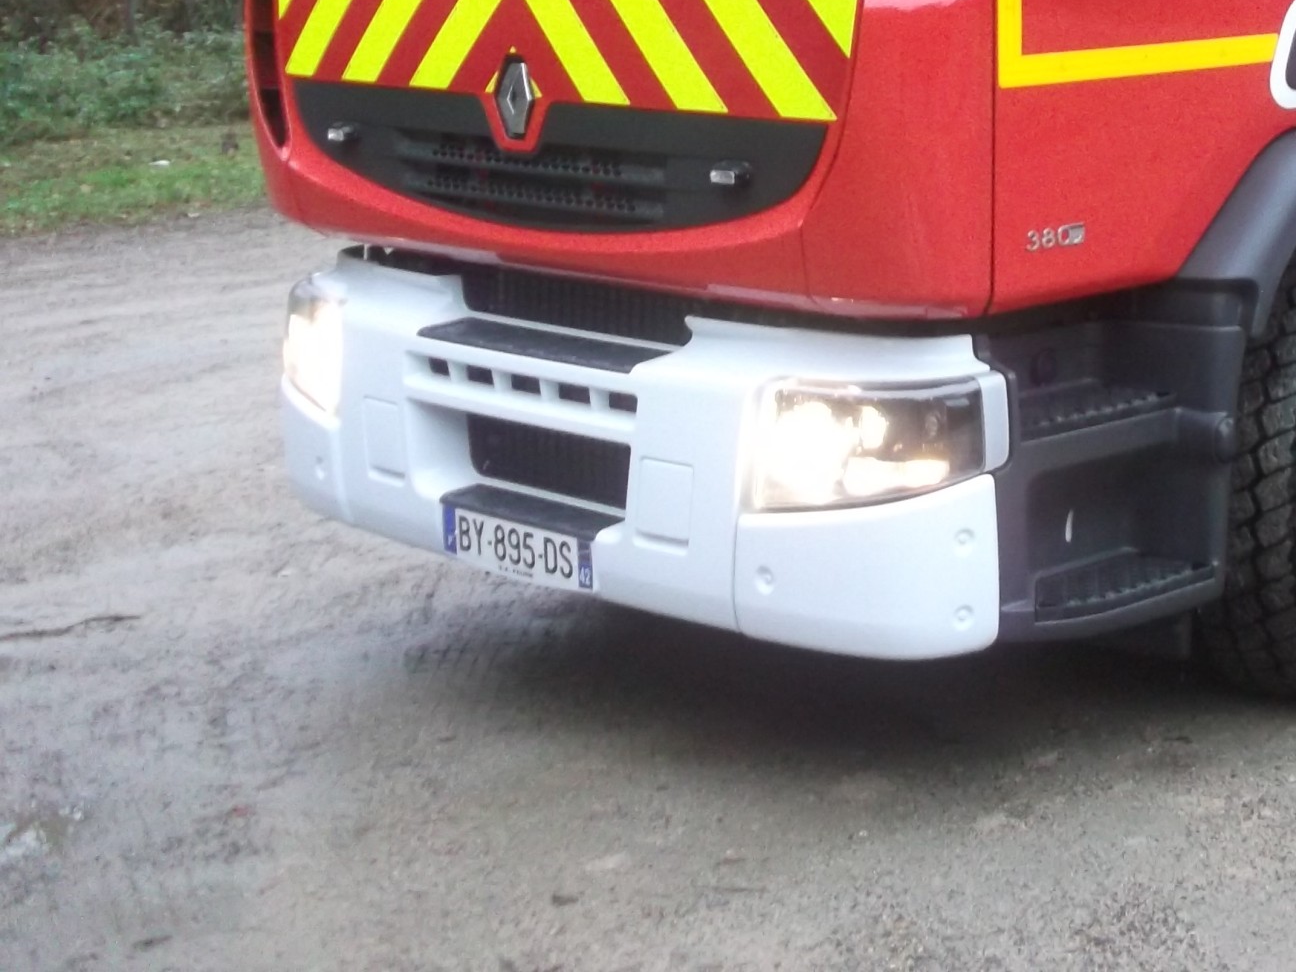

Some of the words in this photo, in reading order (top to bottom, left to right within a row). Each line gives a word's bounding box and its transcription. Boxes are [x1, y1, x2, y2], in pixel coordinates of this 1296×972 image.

[1025, 224, 1070, 252] 380
[458, 515, 574, 579] BY-895-DS
[579, 566, 592, 586] 42
